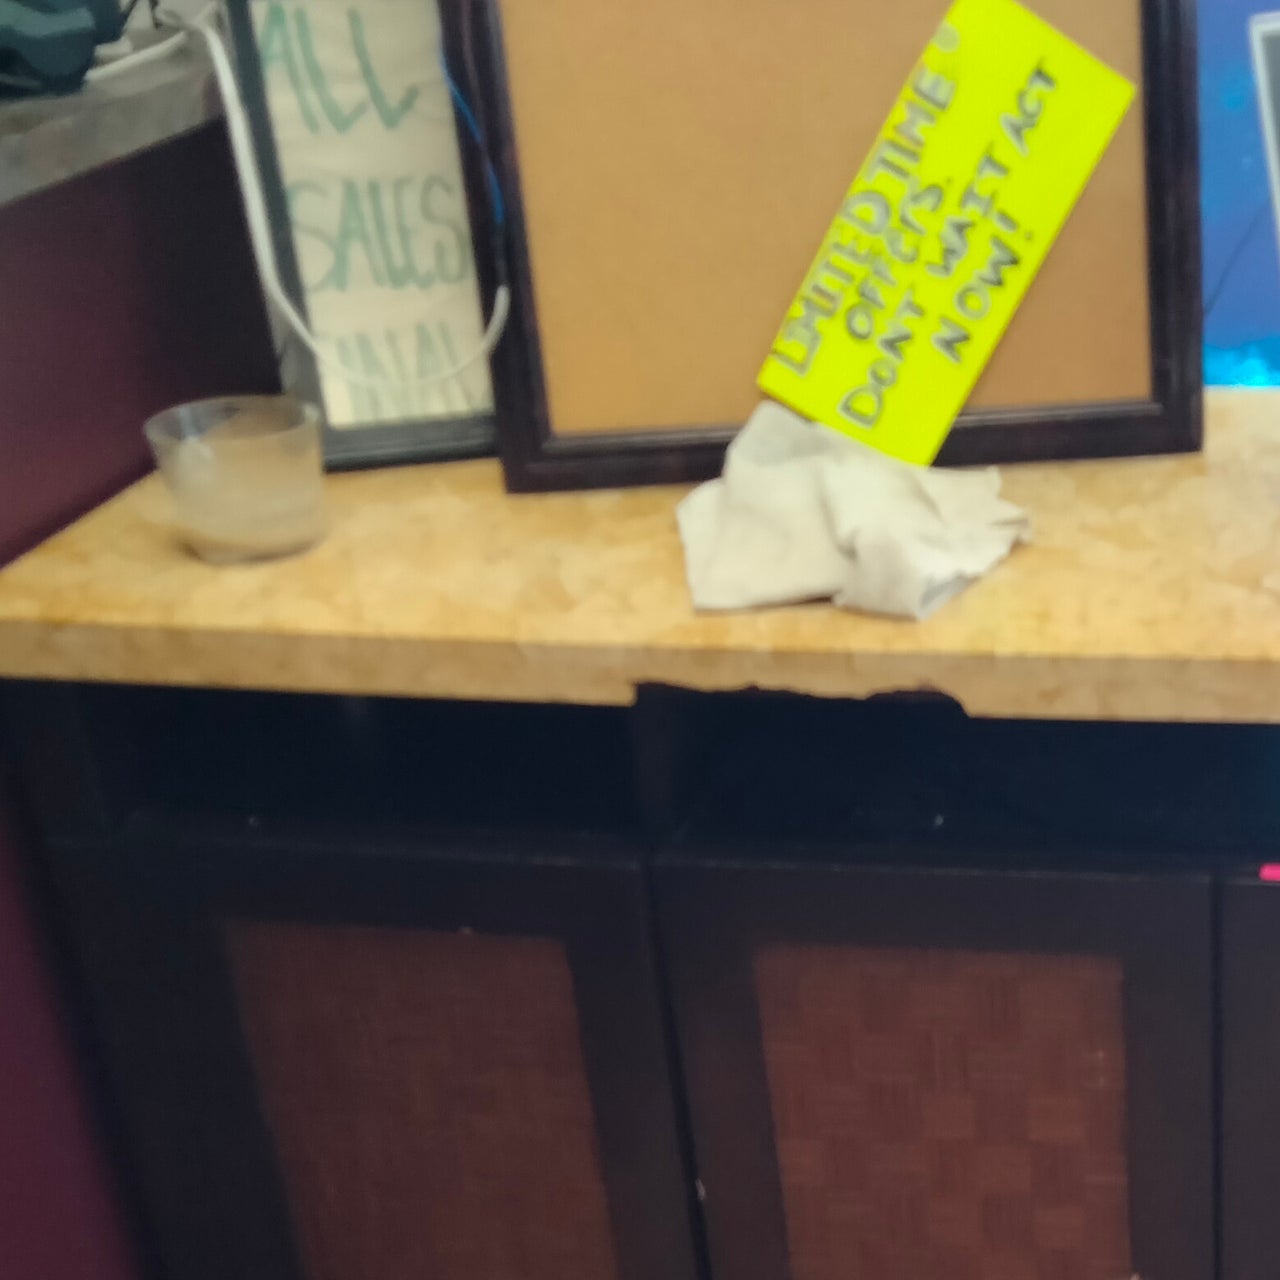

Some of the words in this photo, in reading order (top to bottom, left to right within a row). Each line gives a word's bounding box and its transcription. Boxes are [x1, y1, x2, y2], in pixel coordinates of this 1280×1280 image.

[261, 3, 418, 133] ALL
[288, 174, 470, 294] SALES
[771, 189, 891, 377] LIMITED
[864, 66, 955, 184] TIME
[926, 142, 1009, 278] WAIT
[1000, 58, 1056, 157] ACT
[932, 208, 1033, 364] NOW!
